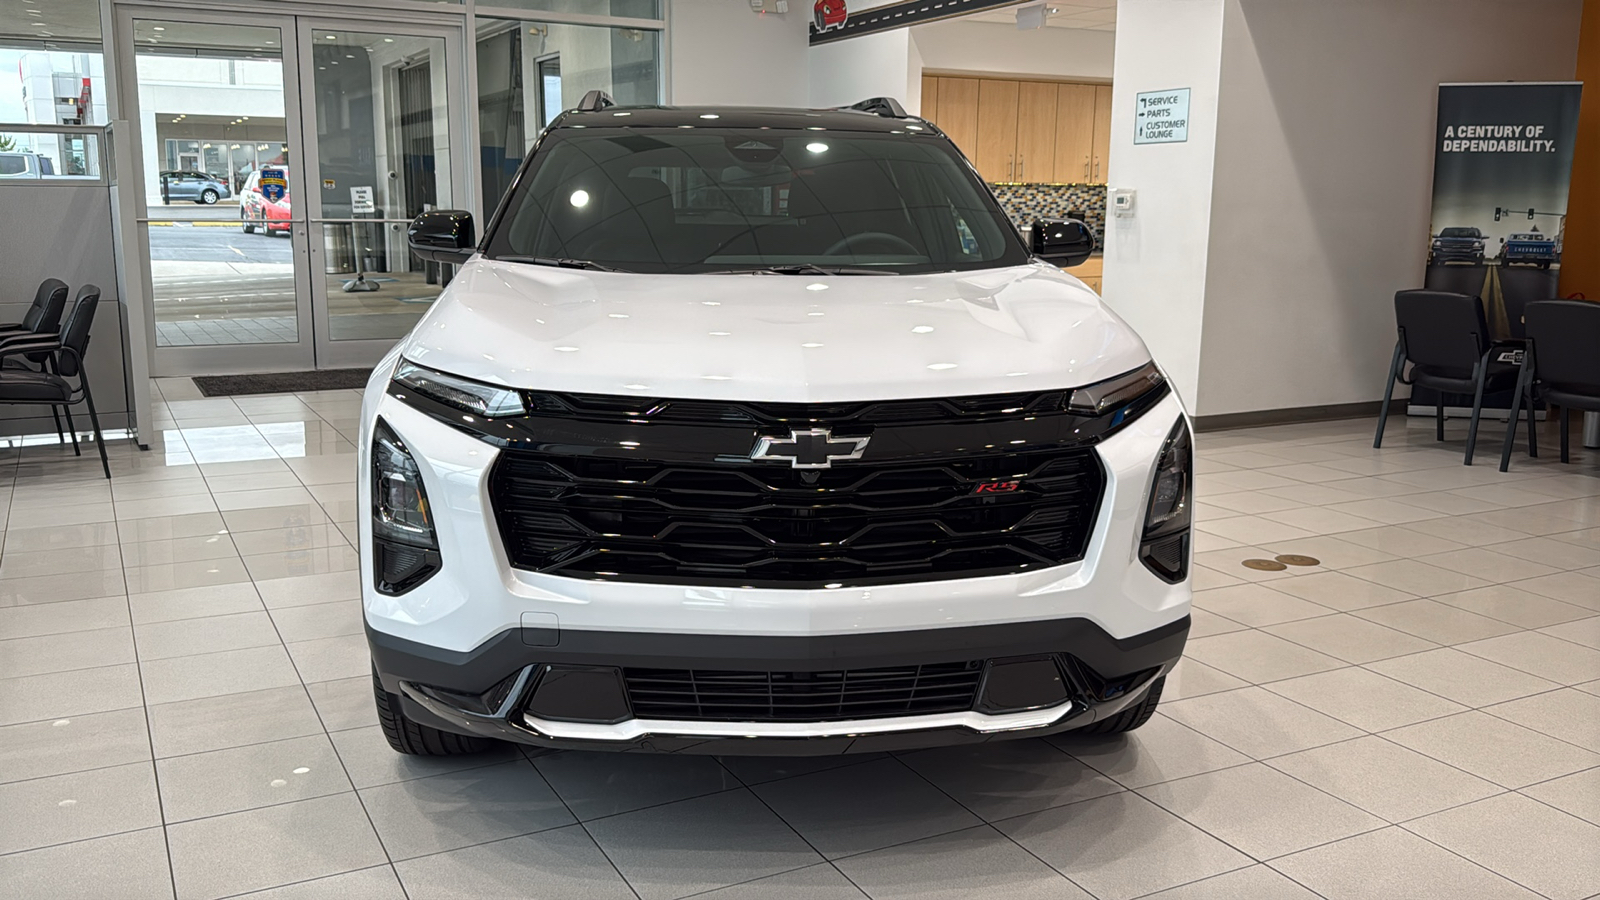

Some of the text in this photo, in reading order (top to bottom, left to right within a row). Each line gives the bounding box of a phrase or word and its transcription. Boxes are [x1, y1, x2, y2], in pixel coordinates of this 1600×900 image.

[1148, 95, 1178, 106] SERVICE
[1147, 108, 1171, 118] PARTS
[1146, 119, 1186, 130] CUSTOMER
[1145, 130, 1173, 139] LOUNGE
[1444, 125, 1544, 138] A CENTURY OF
[1442, 139, 1556, 152] DEPENDABILITY.
[976, 480, 1021, 493] RS
